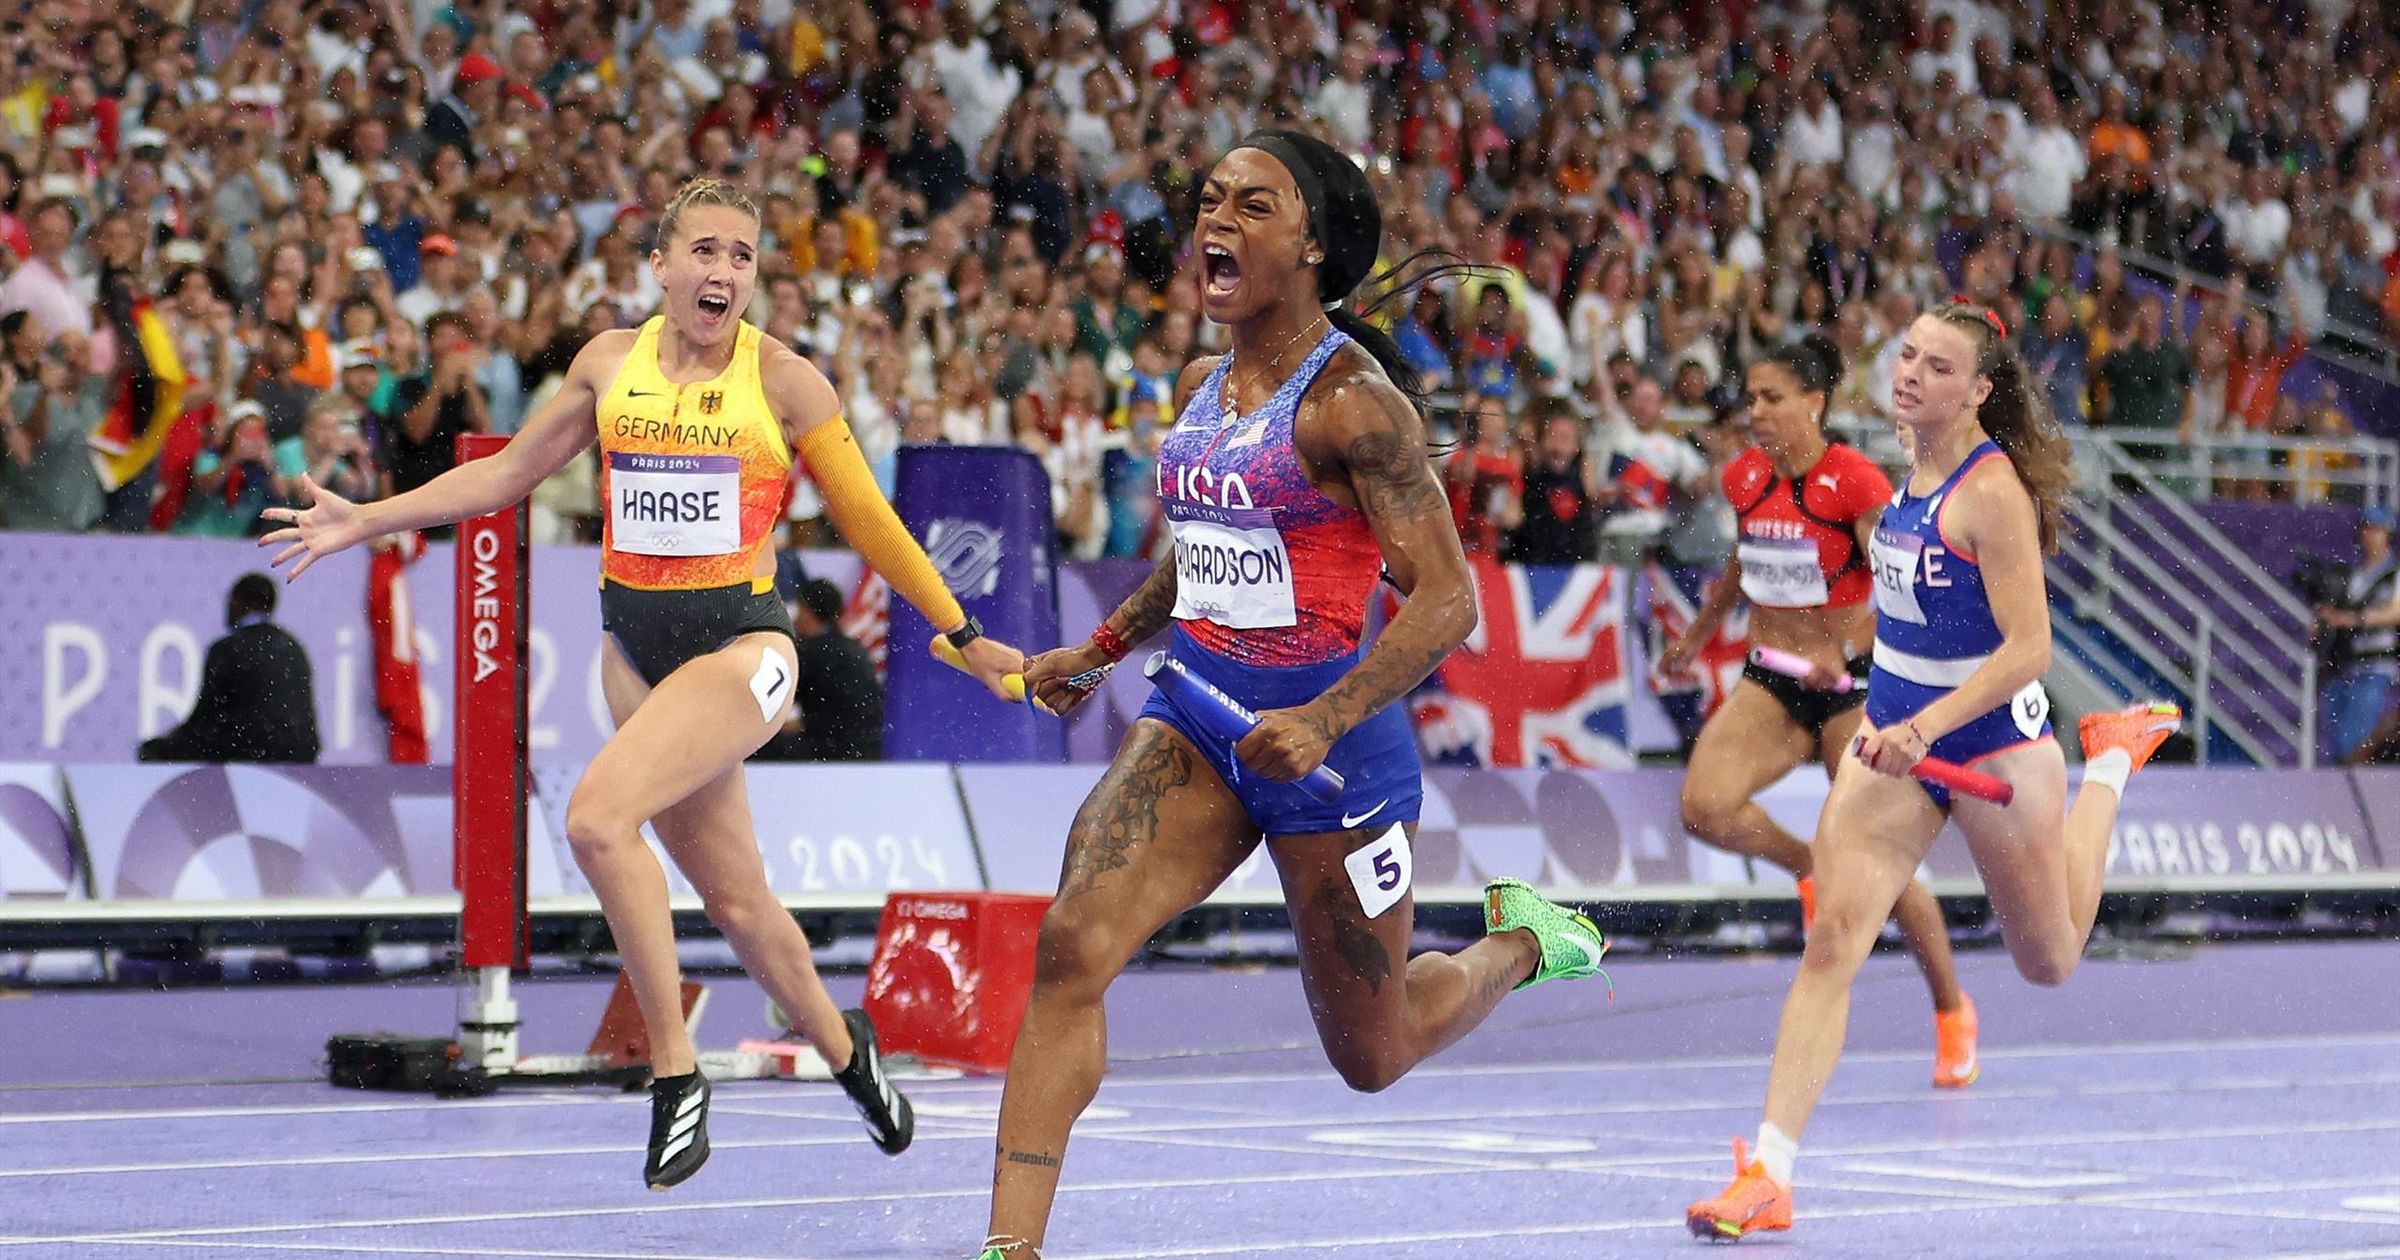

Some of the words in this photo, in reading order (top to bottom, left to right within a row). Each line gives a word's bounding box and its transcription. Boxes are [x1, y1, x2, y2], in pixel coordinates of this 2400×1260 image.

[614, 414, 739, 448] GERMANY
[631, 458, 666, 469] PARIS
[668, 459, 700, 470] 2024
[623, 488, 720, 522] HAASE
[1156, 463, 1254, 510] USA
[473, 529, 499, 683] OMEGA
[766, 665, 785, 698] 7
[1208, 684, 1257, 725] PARIS
[2023, 697, 2040, 719] 6
[788, 833, 948, 889] 2024
[2237, 819, 2360, 875] 2024
[1372, 847, 1402, 892] 5
